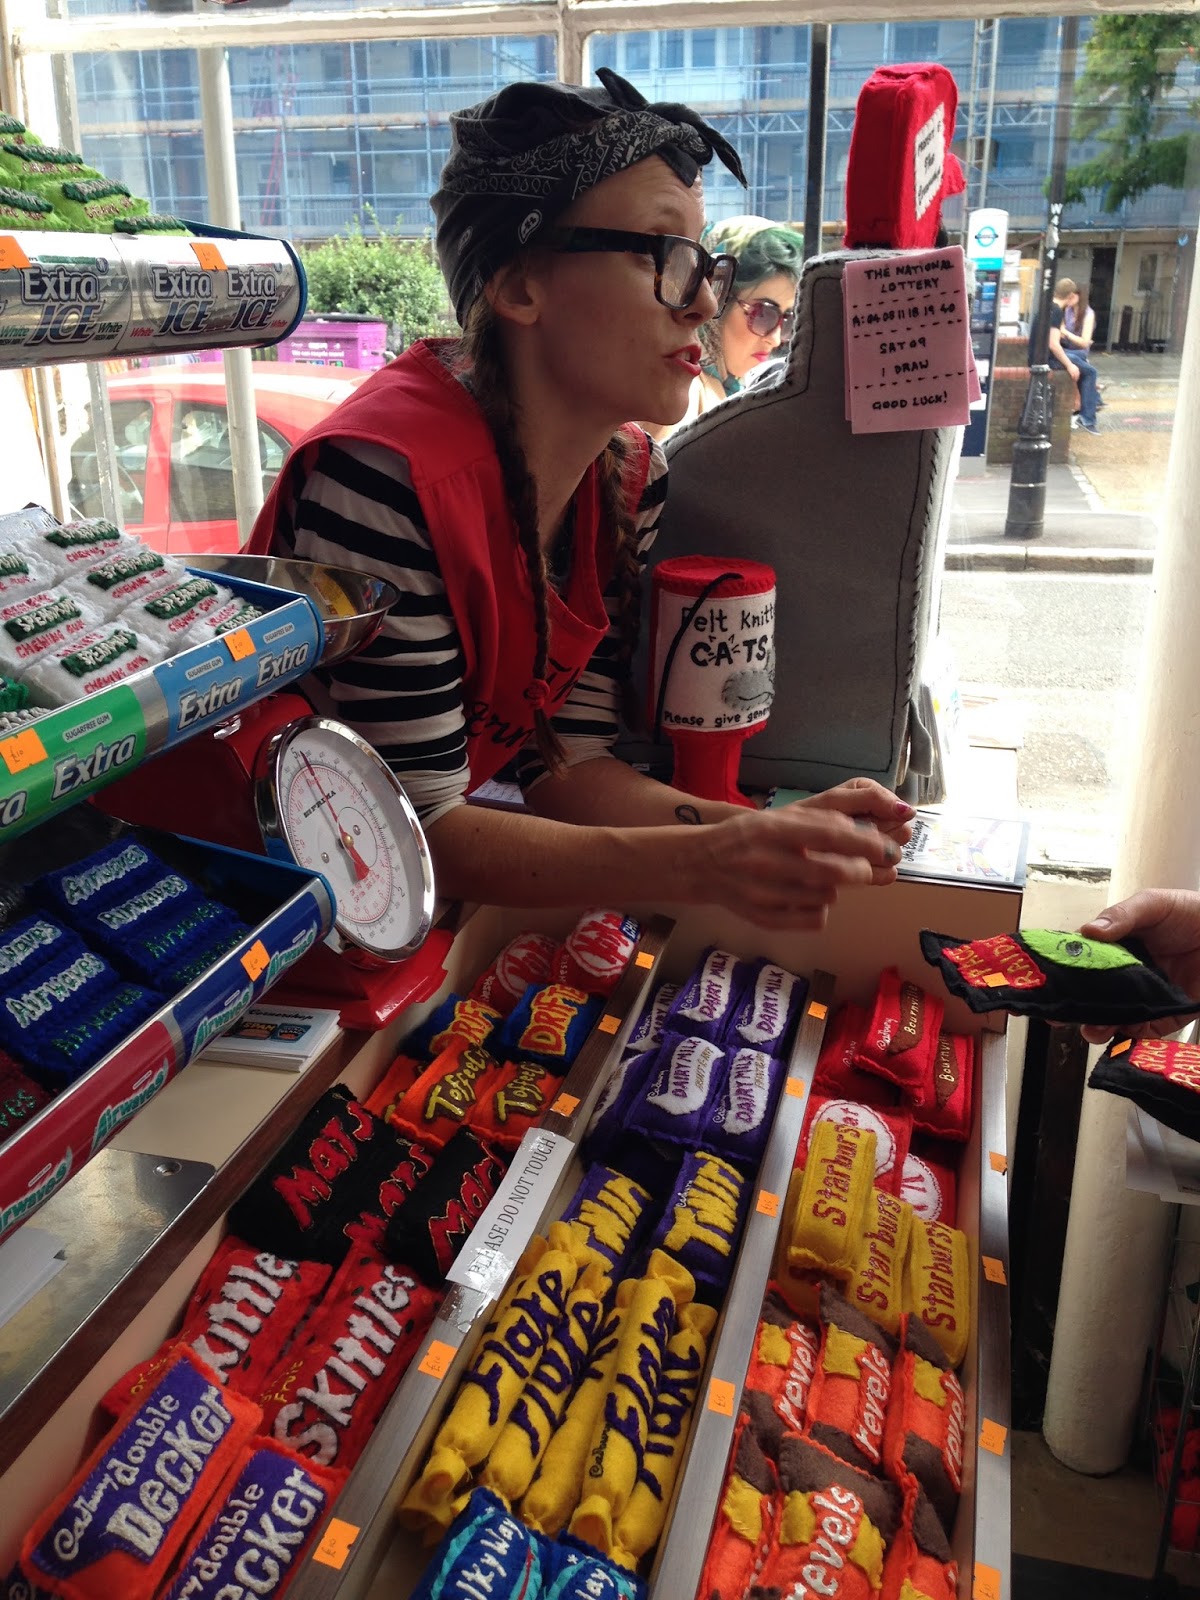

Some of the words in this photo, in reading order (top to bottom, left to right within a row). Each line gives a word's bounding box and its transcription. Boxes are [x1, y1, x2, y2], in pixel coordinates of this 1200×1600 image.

[22, 265, 99, 302] Extra
[152, 267, 214, 299] Extra
[226, 267, 277, 298] Extra
[864, 267, 890, 281] THE
[896, 259, 954, 276] NATIONAL
[880, 277, 940, 294] LOTTERY
[24, 301, 104, 345] ICE
[154, 299, 215, 337] ICE
[224, 299, 280, 332] ICE
[939, 303, 956, 314] 40
[130, 326, 154, 338] White
[879, 341, 907, 354] SAT
[909, 337, 926, 348] 09
[894, 359, 930, 375] DRAW
[872, 399, 908, 410] GOOD
[912, 390, 949, 407] LUCK!
[740, 603, 775, 631] Knitt
[15, 629, 65, 659] CHEWING
[66, 619, 87, 635] GUM
[690, 634, 769, 667] CATS
[187, 661, 211, 679] SUGARFREE
[211, 658, 223, 669] GUM
[256, 642, 309, 689] Extra
[177, 676, 243, 731] Extra
[663, 711, 705, 726] Please
[714, 712, 742, 729] give
[65, 719, 97, 741] SUGARFREE
[97, 714, 111, 726] GUM
[51, 734, 137, 802] Extra
[63, 844, 148, 904] Airwaves
[98, 875, 188, 929] Airwaves
[266, 922, 318, 987] Airwaves
[6, 953, 105, 1029] Airwaves
[699, 980, 722, 1019] DAIRY
[714, 952, 730, 979] MILK
[764, 970, 784, 997] MILK
[191, 984, 254, 1058] Airwaves
[756, 996, 778, 1034] DAIRY
[677, 1039, 702, 1063] MILK
[735, 1054, 754, 1080] MILK
[1132, 1039, 1169, 1071] SPAC
[672, 1063, 692, 1098] DAIRY
[91, 1059, 169, 1153] Airwaves
[735, 1081, 756, 1123] DAIRY
[468, 1223, 509, 1276] PLEASE
[497, 1204, 520, 1225] DO
[511, 1176, 534, 1206] NOT
[524, 1137, 557, 1176] TOUCH
[922, 1220, 957, 1332] Starburst
[274, 1264, 418, 1467] Skittles
[463, 1268, 564, 1427] Flake
[777, 1324, 818, 1430] revels
[856, 1346, 892, 1460] revels
[53, 1471, 121, 1562] Cadbury
[107, 1394, 181, 1488] double
[194, 1482, 265, 1583] double
[321, 1538, 337, 1560] £10
[480, 1517, 525, 1556] Way
